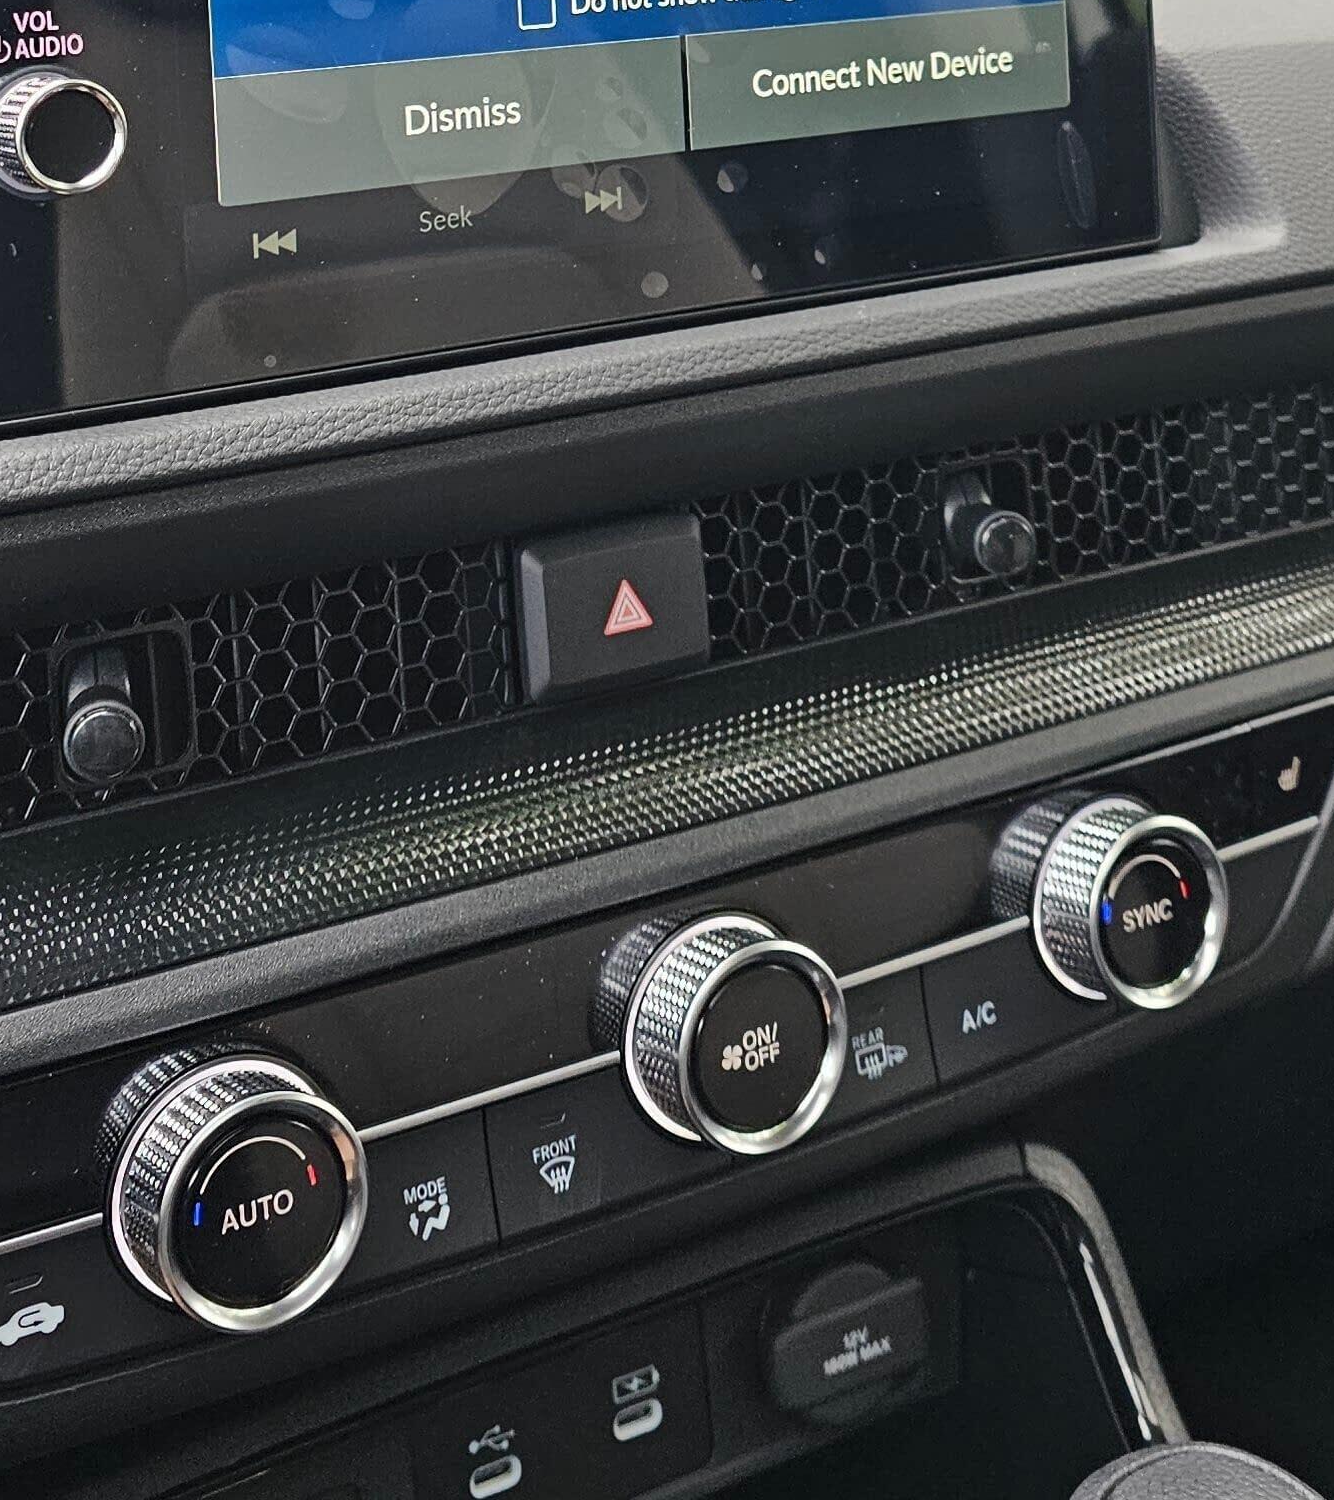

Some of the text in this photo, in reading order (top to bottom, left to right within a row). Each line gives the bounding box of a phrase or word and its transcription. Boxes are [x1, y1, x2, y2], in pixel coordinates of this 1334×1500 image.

[13, 11, 59, 33] VOL
[15, 33, 84, 60] AUDIO
[752, 47, 1013, 98] Connect New Device
[405, 97, 521, 136] Dismiss
[419, 205, 473, 233] Seek
[1122, 898, 1174, 933] SYNC
[962, 1000, 998, 1034] A/C
[851, 1026, 884, 1049] REAR
[744, 1041, 781, 1072] OFF
[532, 1134, 577, 1165] FRONT
[403, 1176, 448, 1205] MODE
[221, 1189, 294, 1235] AUTO
